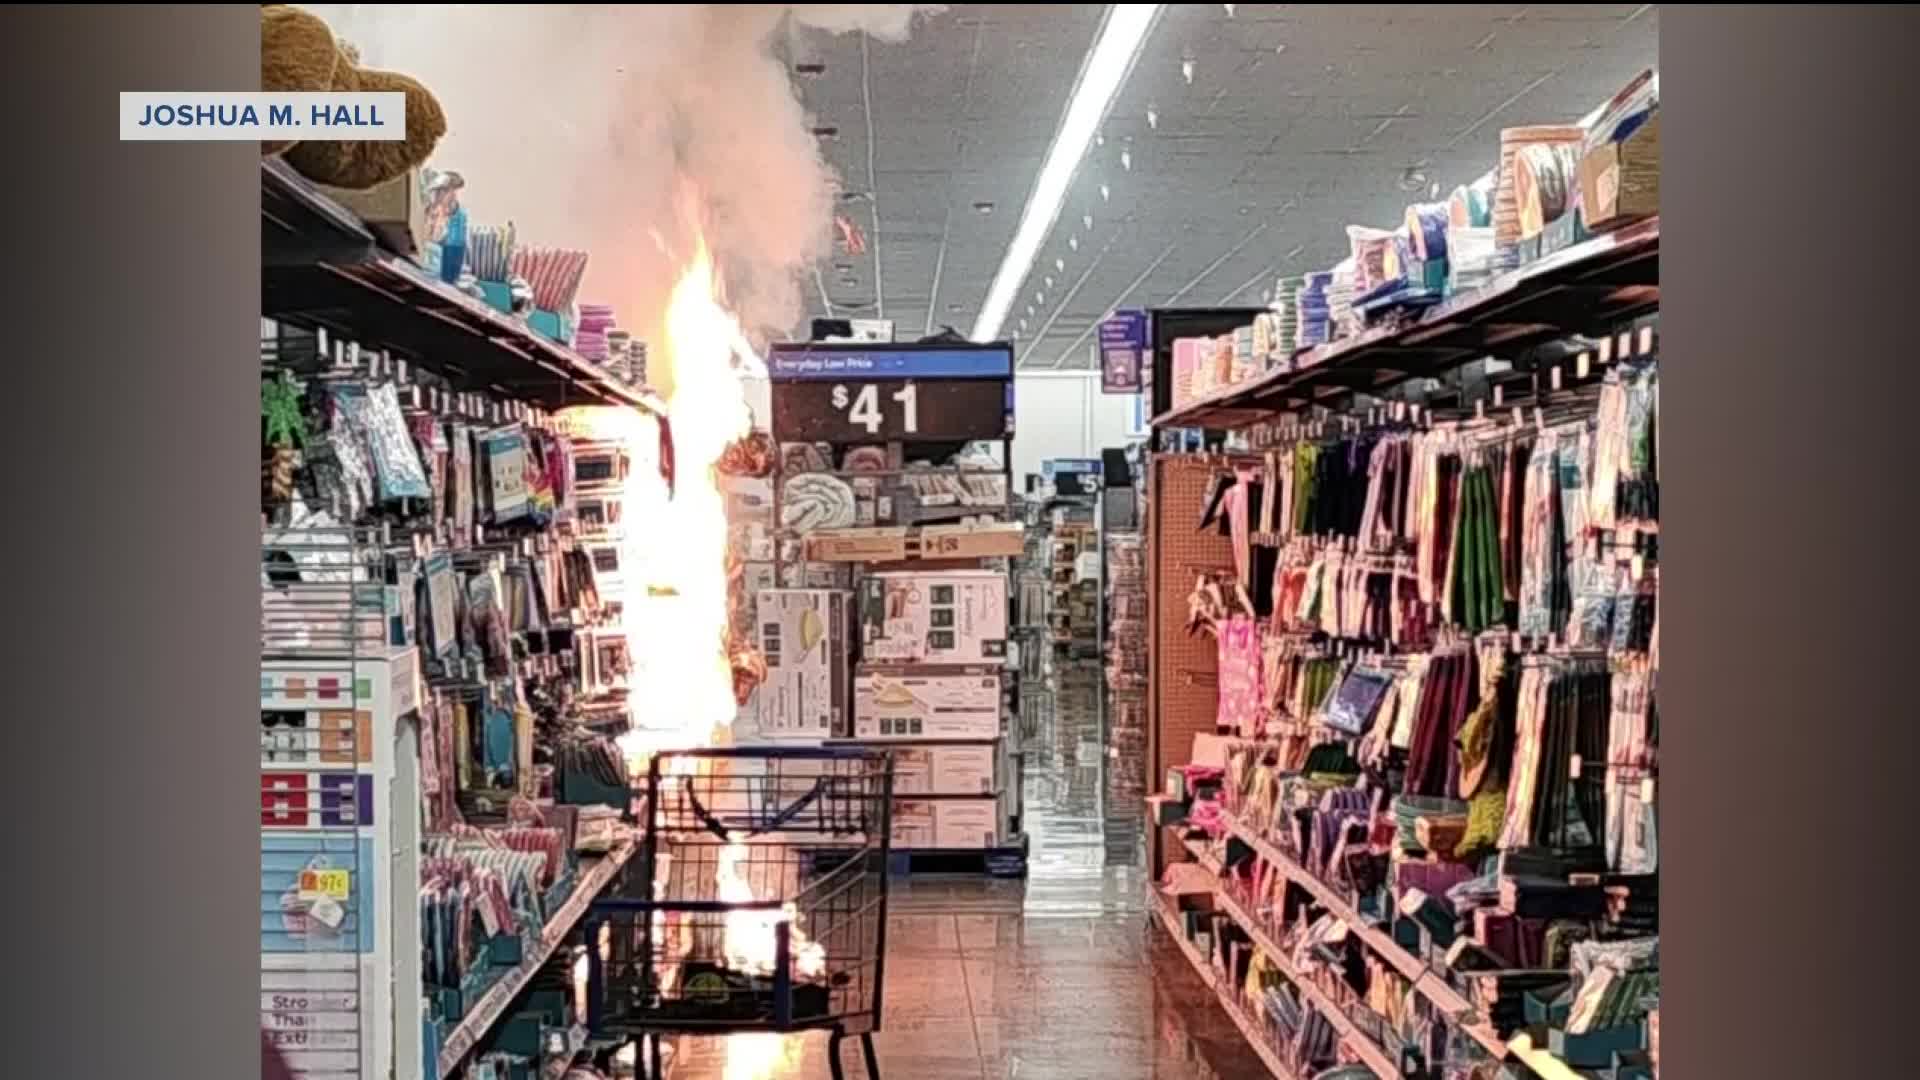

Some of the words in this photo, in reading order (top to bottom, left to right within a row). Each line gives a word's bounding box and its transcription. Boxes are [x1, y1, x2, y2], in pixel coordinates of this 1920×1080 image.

[775, 357, 823, 371] Everyday
[824, 357, 845, 369] Low
[846, 356, 873, 369] Price
[831, 383, 918, 433] $41
